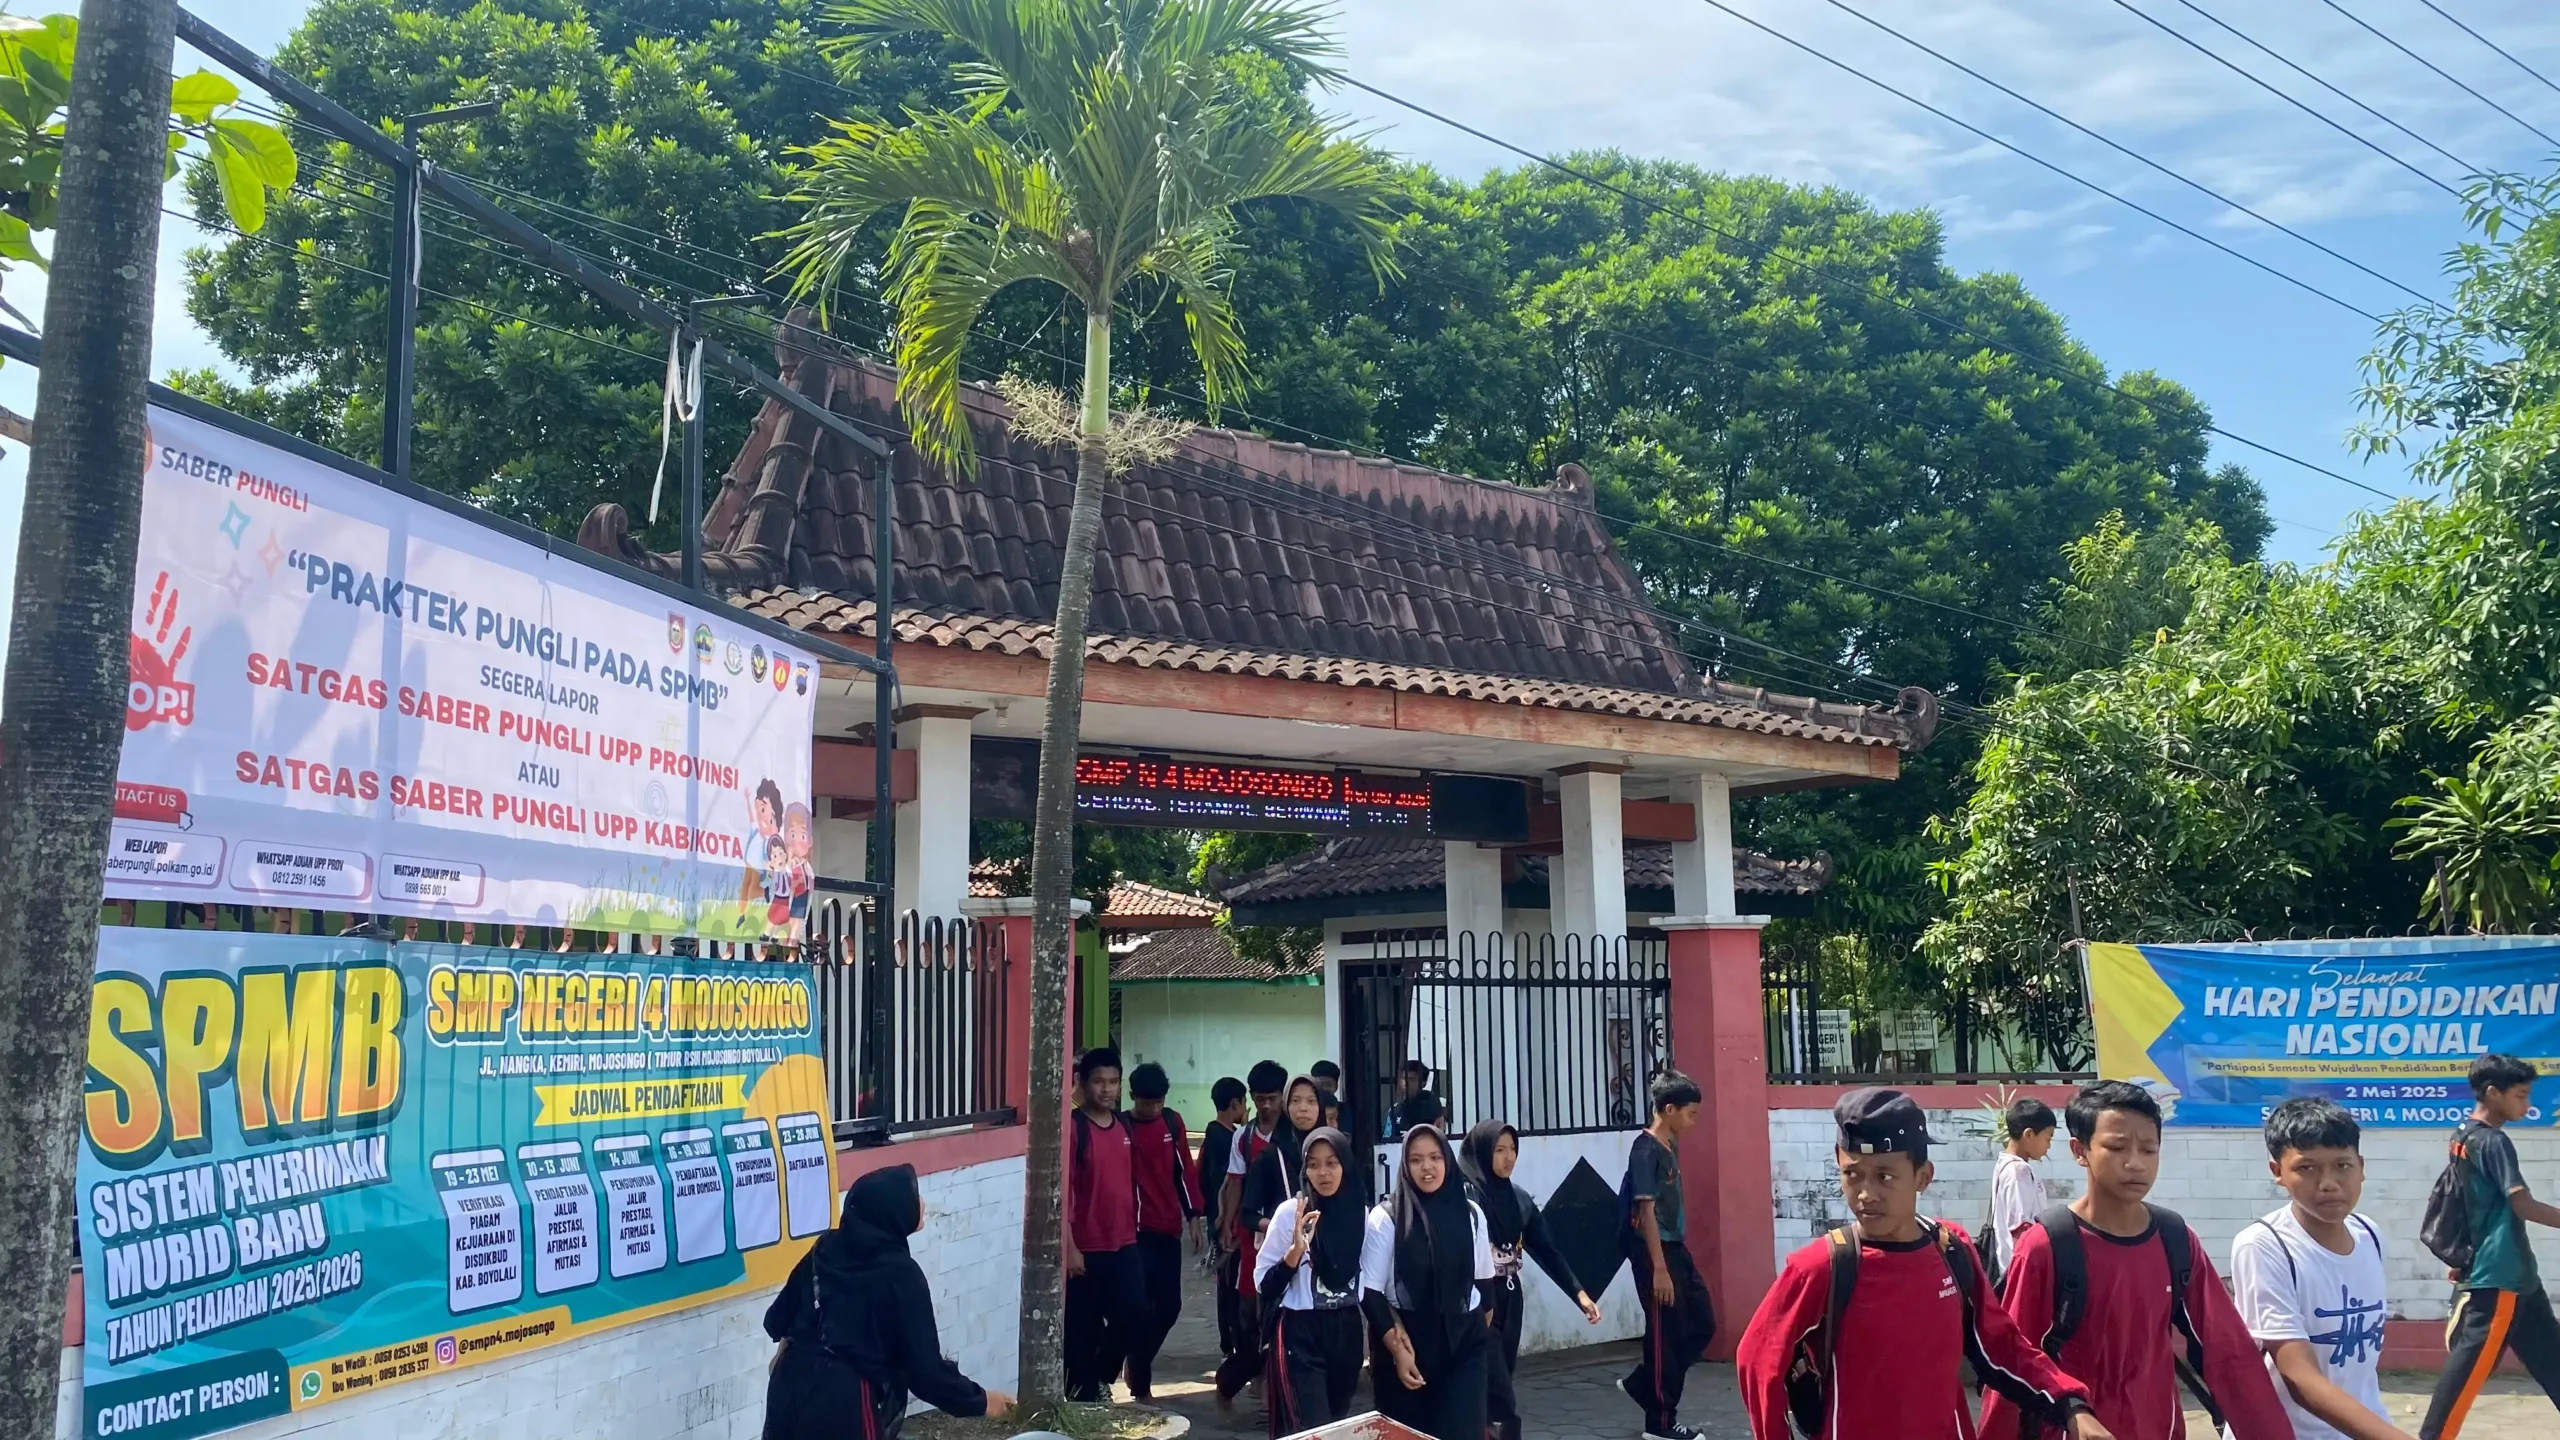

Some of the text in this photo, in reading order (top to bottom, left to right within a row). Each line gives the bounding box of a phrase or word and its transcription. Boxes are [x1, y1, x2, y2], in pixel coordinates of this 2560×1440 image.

[161, 447, 308, 512] SABER PUNGLI
[475, 606, 578, 669] PUNGLI
[584, 641, 653, 692] PADA
[480, 665, 599, 715] SEGERA LAPOR
[128, 681, 189, 719] OP!
[246, 652, 739, 790] SATGAS SABER PUNGLI UPP PROVINSI
[518, 761, 560, 788] ATAU
[1139, 763, 1157, 787] N
[1162, 765, 1177, 789] 4
[1184, 767, 1333, 800] MOJOSONGO
[114, 788, 177, 807] NTACT US
[236, 751, 379, 800] SATGAS
[390, 775, 483, 818] SABER
[492, 793, 586, 834] PUNGLI
[594, 811, 638, 841] UPP
[124, 838, 168, 855] WEB LAPOR
[107, 856, 215, 877] aberpungli.polkam.go.id/
[257, 851, 344, 871] WHATSAPP ADUAN UPP PROV
[394, 864, 420, 877] WHATSAPP
[291, 873, 307, 886] 2591
[309, 874, 326, 887] 1456
[420, 883, 431, 895] 665
[2308, 957, 2448, 995] Selamat
[428, 967, 810, 1036] SMP NEGERI 4 MOJOSONGO
[2204, 983, 2559, 1018] HARI PENDIDIKAN
[2286, 1022, 2489, 1056] NASIONAL
[83, 964, 404, 1158] SPMB
[500, 1055, 547, 1075] NANGKA,
[549, 1053, 586, 1073] KEMIRI,
[588, 1052, 647, 1071] MOJOSONGO
[655, 1051, 682, 1068] TIMUR
[702, 1049, 741, 1066] MOJOSONGO
[742, 1047, 776, 1063] BOYOLALI
[2268, 1063, 2316, 1073] Semesta
[2318, 1063, 2378, 1075] Wujudkan
[2380, 1063, 2447, 1073] Pendidikan
[570, 1081, 724, 1117] JADWAL PENDAFTARAN
[2345, 1085, 2448, 1098] 2 Mei 2025
[2350, 1106, 2541, 1121] ERI 4 MOJOSO
[734, 1134, 762, 1150] 20 JUNI
[782, 1130, 791, 1143] 23
[805, 1127, 820, 1140] JUNI
[693, 1140, 712, 1156] JUNI
[526, 1161, 538, 1177] 10
[545, 1159, 556, 1174] 13
[559, 1156, 581, 1173] JUNI
[609, 1149, 640, 1167] 14 JUNI
[789, 1155, 825, 1171] DAFTAR ULANG
[444, 1171, 457, 1187] 19
[465, 1168, 480, 1184] 23
[482, 1165, 499, 1182] MEI
[611, 1175, 656, 1191] PENGUMUMAN
[675, 1166, 718, 1181] PENDAFTARAN
[735, 1170, 776, 1188] JALUR DOMISILI
[92, 1135, 388, 1239] SISTEM PENERIMAAN
[534, 1183, 589, 1202] PENDAFTARAN
[676, 1180, 722, 1198] JALUR DOMISILI
[458, 1195, 505, 1213] VERIFIKASI
[626, 1191, 647, 1206] JALUR
[554, 1202, 578, 1217] JALUR
[621, 1207, 653, 1223] PRESTASI,
[470, 1213, 500, 1230] PIAGAM
[548, 1218, 585, 1236] PRESTASI,
[456, 1229, 515, 1251] KEJUARAAN DI
[619, 1223, 656, 1241] AFIRMASI &
[104, 1202, 326, 1300] MURID BARU
[546, 1235, 588, 1255] AFIRMASI &
[627, 1240, 651, 1256] MUTASI
[464, 1249, 508, 1270] DISDIKBUD
[554, 1254, 581, 1271] MUTASI
[455, 1266, 517, 1291] KAB. BOYOLALI
[106, 1251, 362, 1360] TAHUN PELAJARAN 2025/2026
[458, 1320, 555, 1354] @smpn4.mojosongo
[332, 1362, 343, 1375] Ibu
[97, 1388, 196, 1437] CONTACT
[199, 1371, 269, 1405] PERSON
